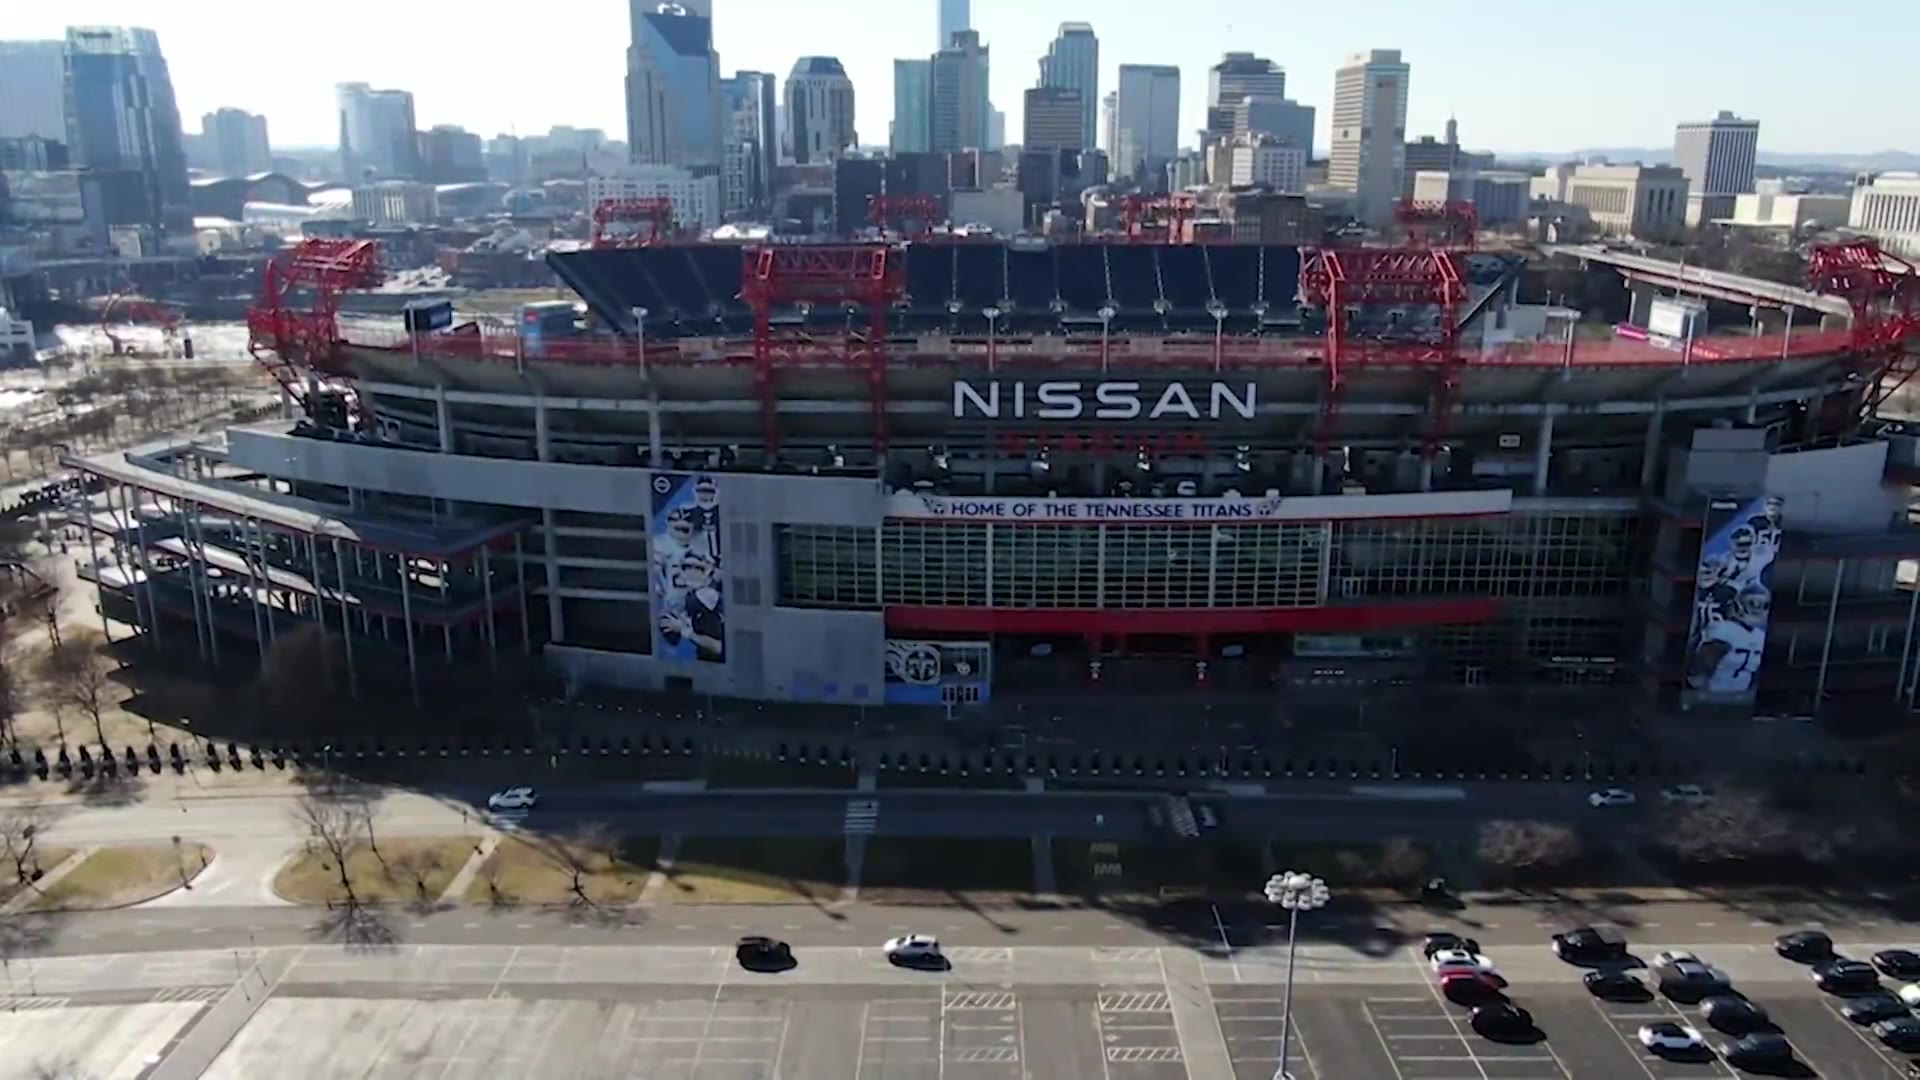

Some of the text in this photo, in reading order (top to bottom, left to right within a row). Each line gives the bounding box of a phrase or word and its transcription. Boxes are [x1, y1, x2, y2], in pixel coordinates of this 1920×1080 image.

[953, 381, 1257, 419] NISSAN
[951, 502, 1252, 518] HOME OF THE TENNESSEE TITANS
